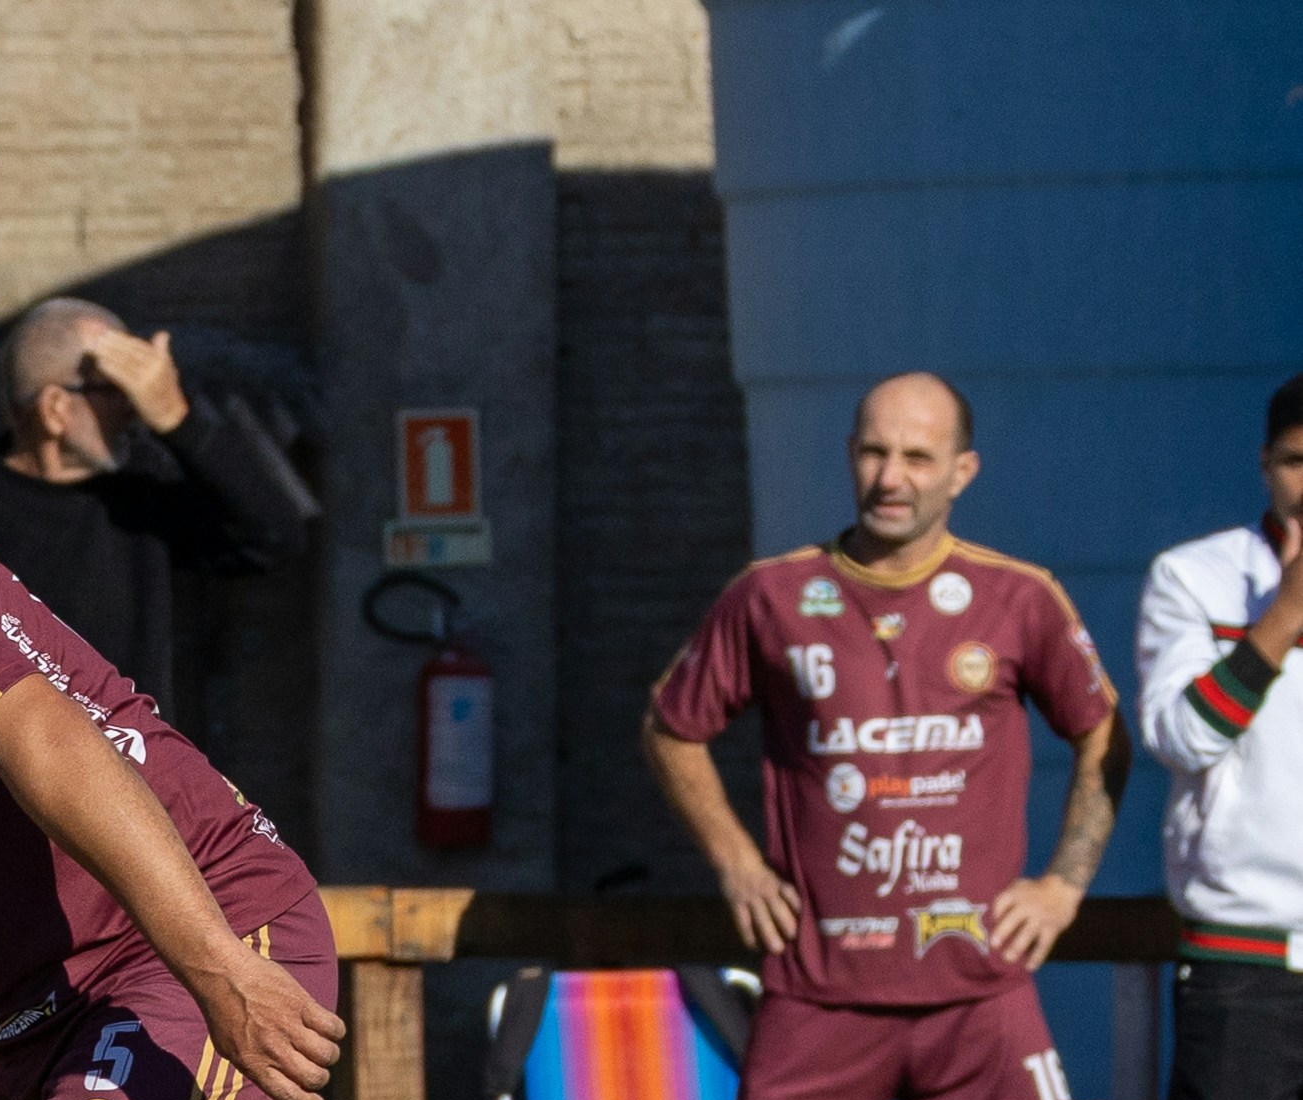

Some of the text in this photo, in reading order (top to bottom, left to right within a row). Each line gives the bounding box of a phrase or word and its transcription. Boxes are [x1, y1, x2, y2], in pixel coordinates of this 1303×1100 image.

[785, 642, 835, 700] 16
[807, 714, 984, 755] LACEMA
[837, 819, 962, 897] Safira
[84, 1021, 142, 1091] 5
